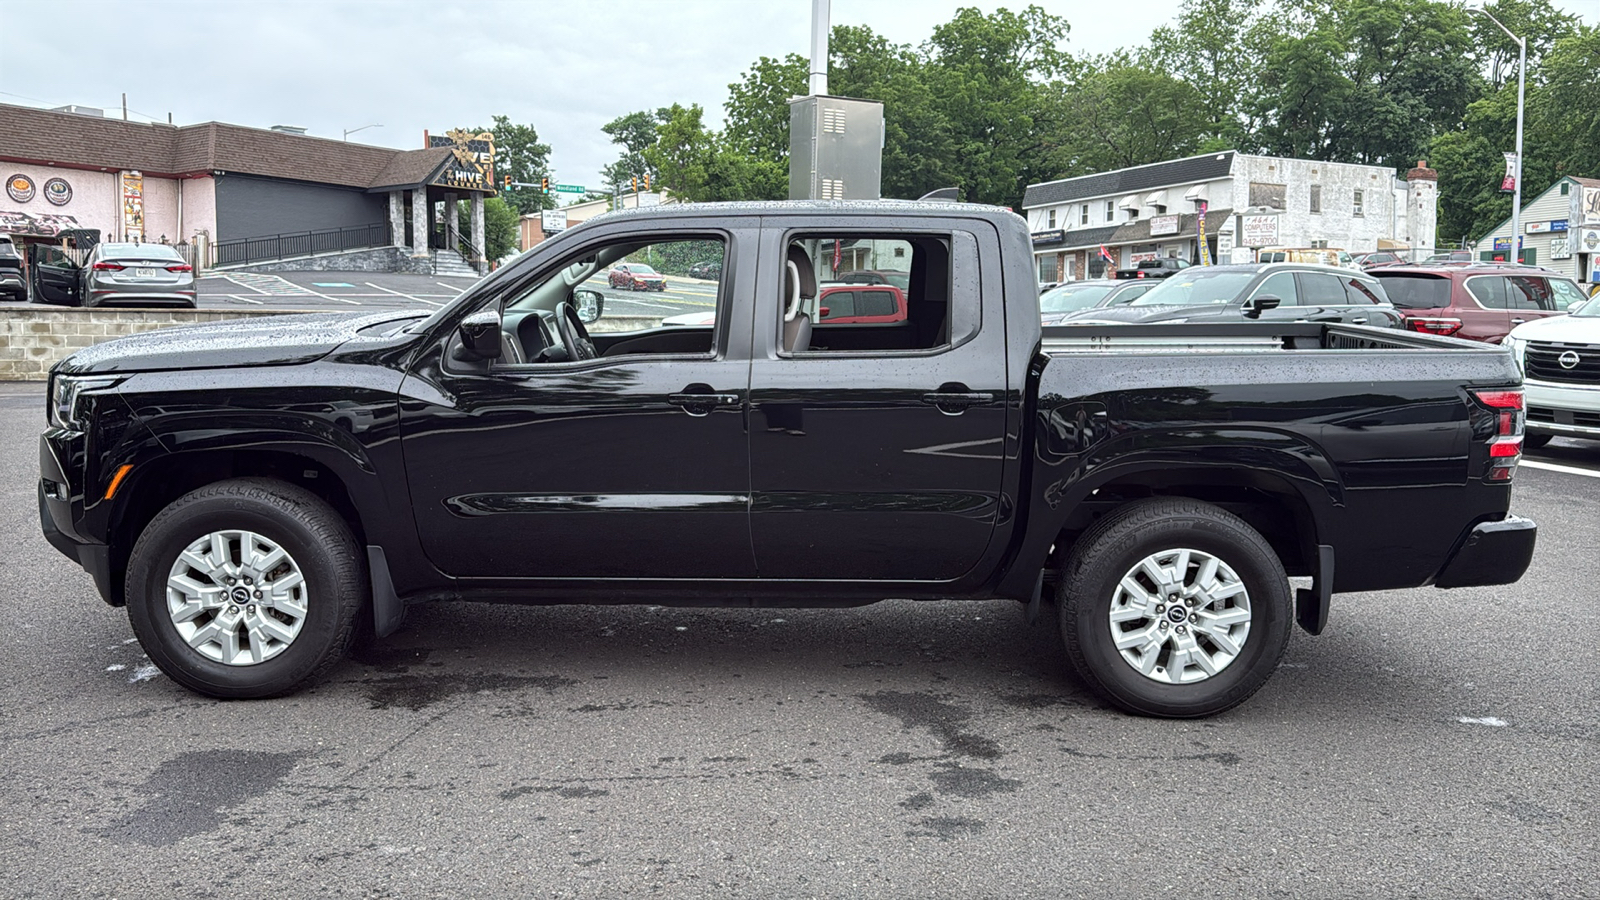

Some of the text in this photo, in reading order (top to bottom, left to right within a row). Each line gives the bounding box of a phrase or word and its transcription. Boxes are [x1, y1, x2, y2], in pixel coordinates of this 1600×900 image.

[455, 170, 483, 184] HIVE
[447, 180, 482, 189] LOUNGE
[1244, 223, 1276, 231] COMPUTERS
